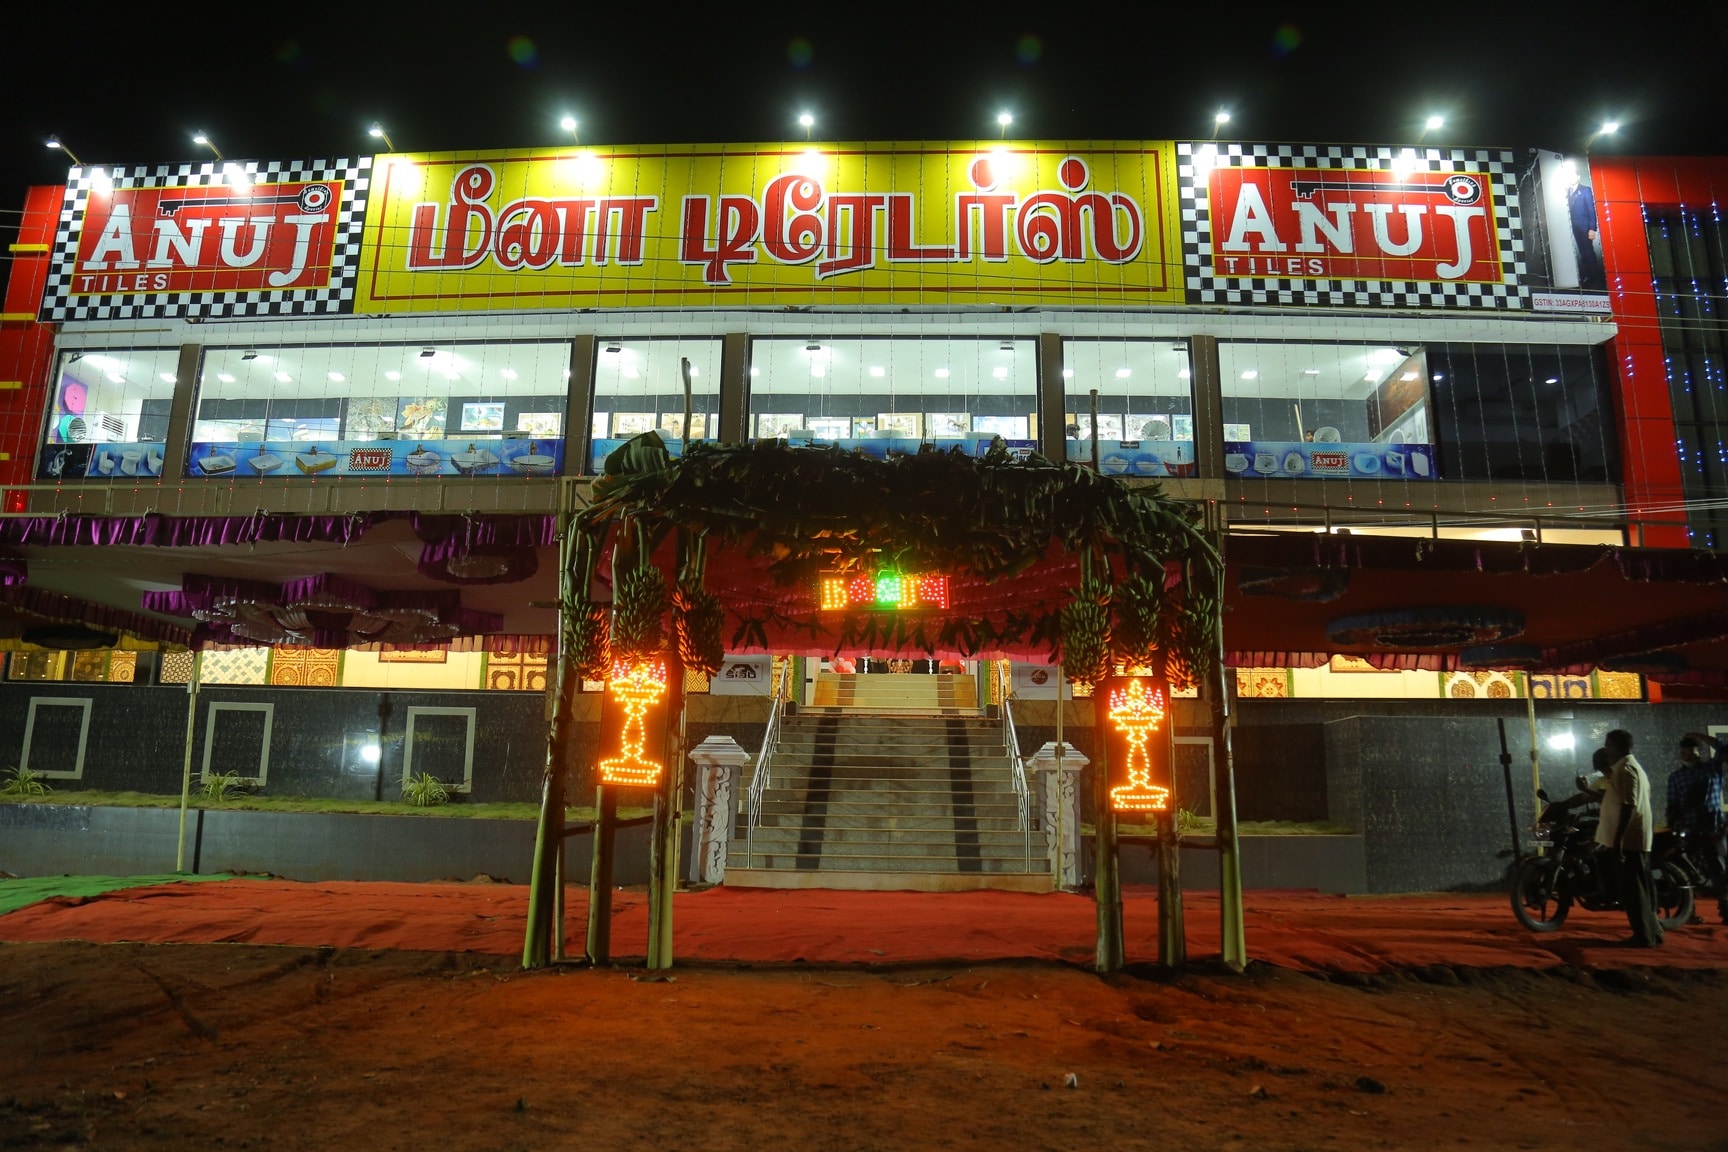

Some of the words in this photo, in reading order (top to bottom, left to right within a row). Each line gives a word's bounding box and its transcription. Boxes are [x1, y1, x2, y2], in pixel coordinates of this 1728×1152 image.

[406, 163, 657, 271] மீனா
[680, 156, 1144, 285] டிரேடர்ஸ்
[1222, 182, 1485, 279] ANUJ
[83, 204, 329, 287] ANUJ
[1224, 257, 1323, 276] TILES
[82, 274, 168, 292] TILES
[354, 455, 387, 467] ANUJ
[1315, 456, 1344, 467] ANUJ
